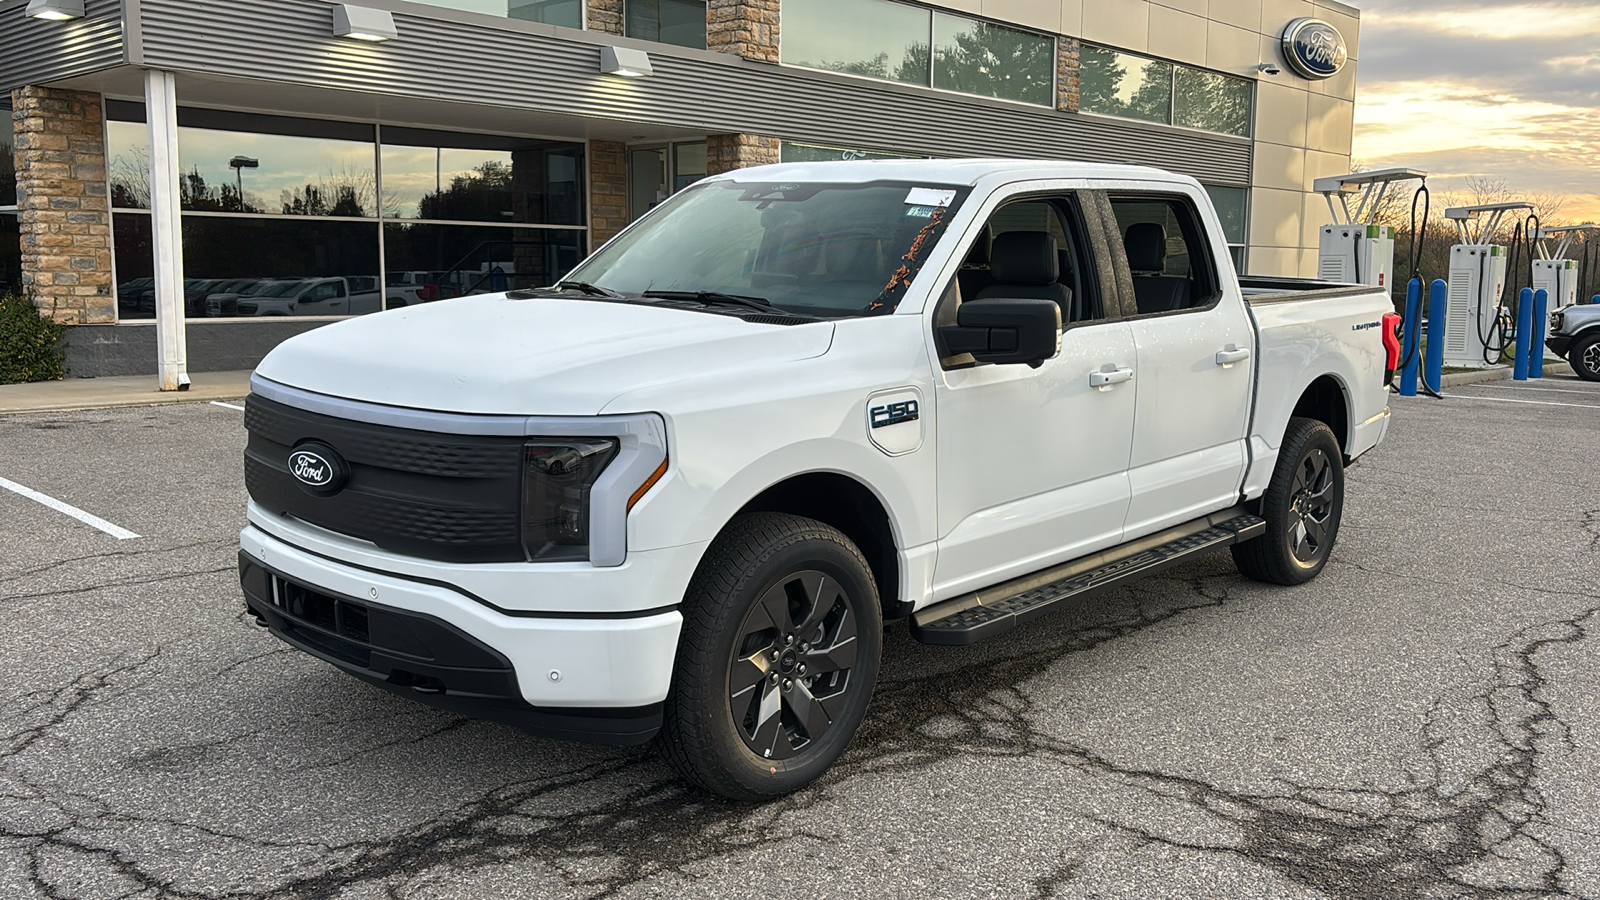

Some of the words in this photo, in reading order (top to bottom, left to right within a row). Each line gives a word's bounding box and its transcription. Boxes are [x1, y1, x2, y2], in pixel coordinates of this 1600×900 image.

[1306, 31, 1340, 66] Ford
[870, 399, 919, 424] F-150
[295, 455, 324, 481] Ford
